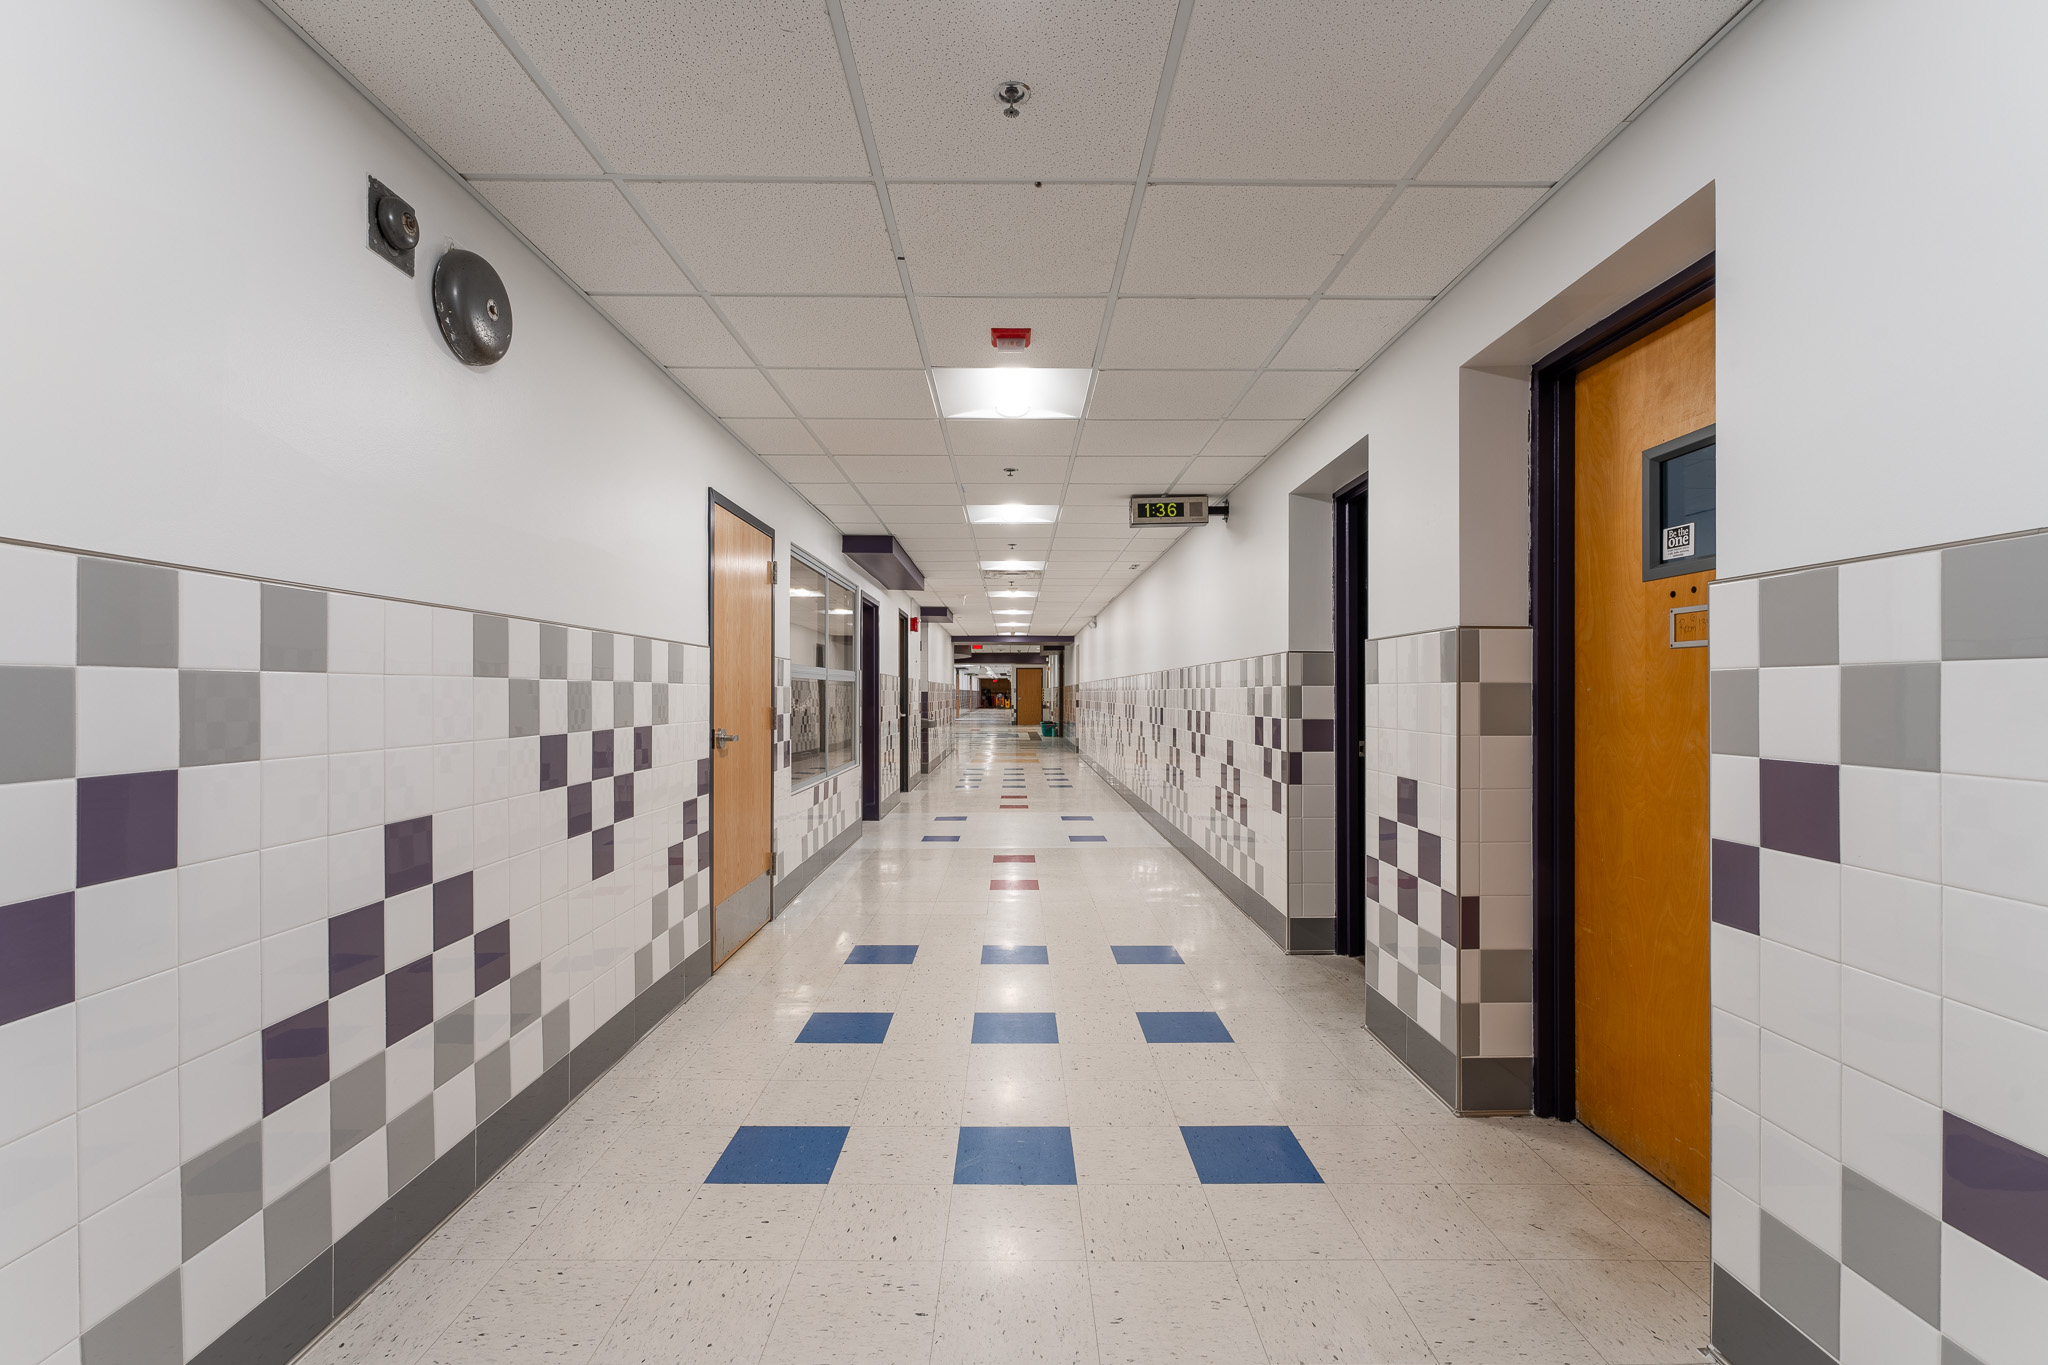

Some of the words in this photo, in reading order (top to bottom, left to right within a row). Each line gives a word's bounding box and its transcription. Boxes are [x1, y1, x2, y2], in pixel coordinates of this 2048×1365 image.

[1144, 502, 1177, 518] 1:36
[1668, 530, 1677, 539] Be
[1677, 527, 1689, 537] the
[1668, 535, 1689, 548] one
[1698, 617, 1709, 631] 13
